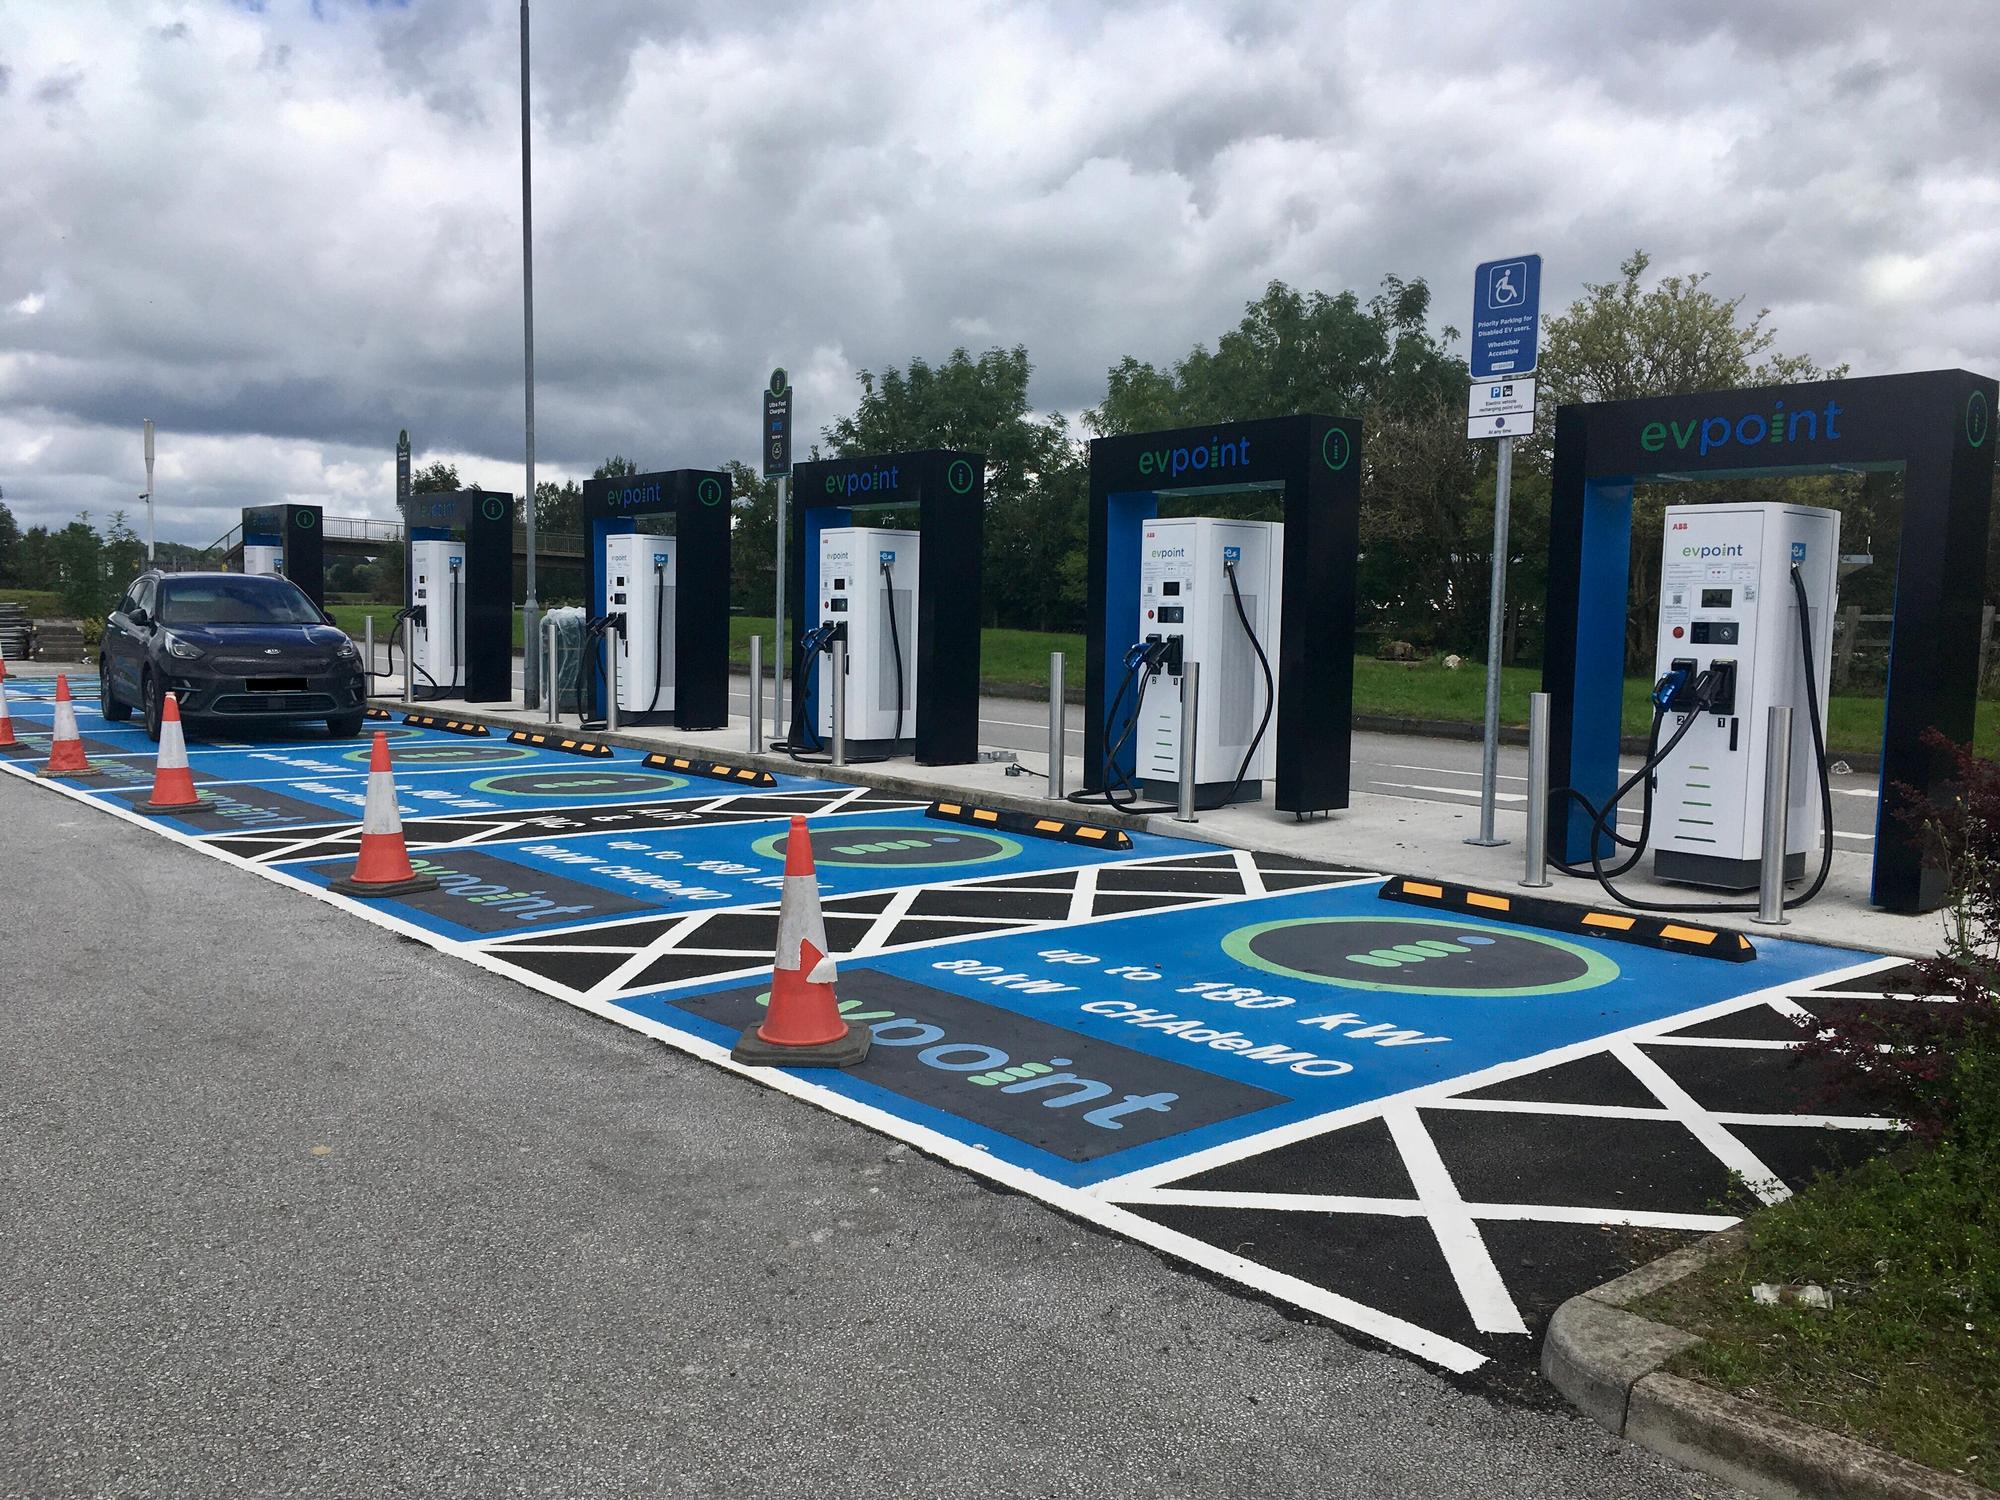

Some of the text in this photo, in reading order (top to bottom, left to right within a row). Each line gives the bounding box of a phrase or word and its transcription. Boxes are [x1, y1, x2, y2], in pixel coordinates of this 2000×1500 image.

[1478, 320, 1500, 328] Priority
[1500, 317, 1523, 325] Parking
[1488, 339, 1520, 348] Wheelchair
[1640, 400, 1845, 456] evpoint
[1138, 435, 1250, 477] evpoint
[607, 481, 661, 508] evpoint
[825, 465, 899, 497] evpoint
[1152, 547, 1185, 559] evpoint
[1682, 543, 1743, 559] evpoint
[1037, 949, 1097, 967] up
[1103, 965, 1163, 982] to
[1176, 981, 1297, 1011] 180
[1080, 999, 1355, 1077] CHAdeMO
